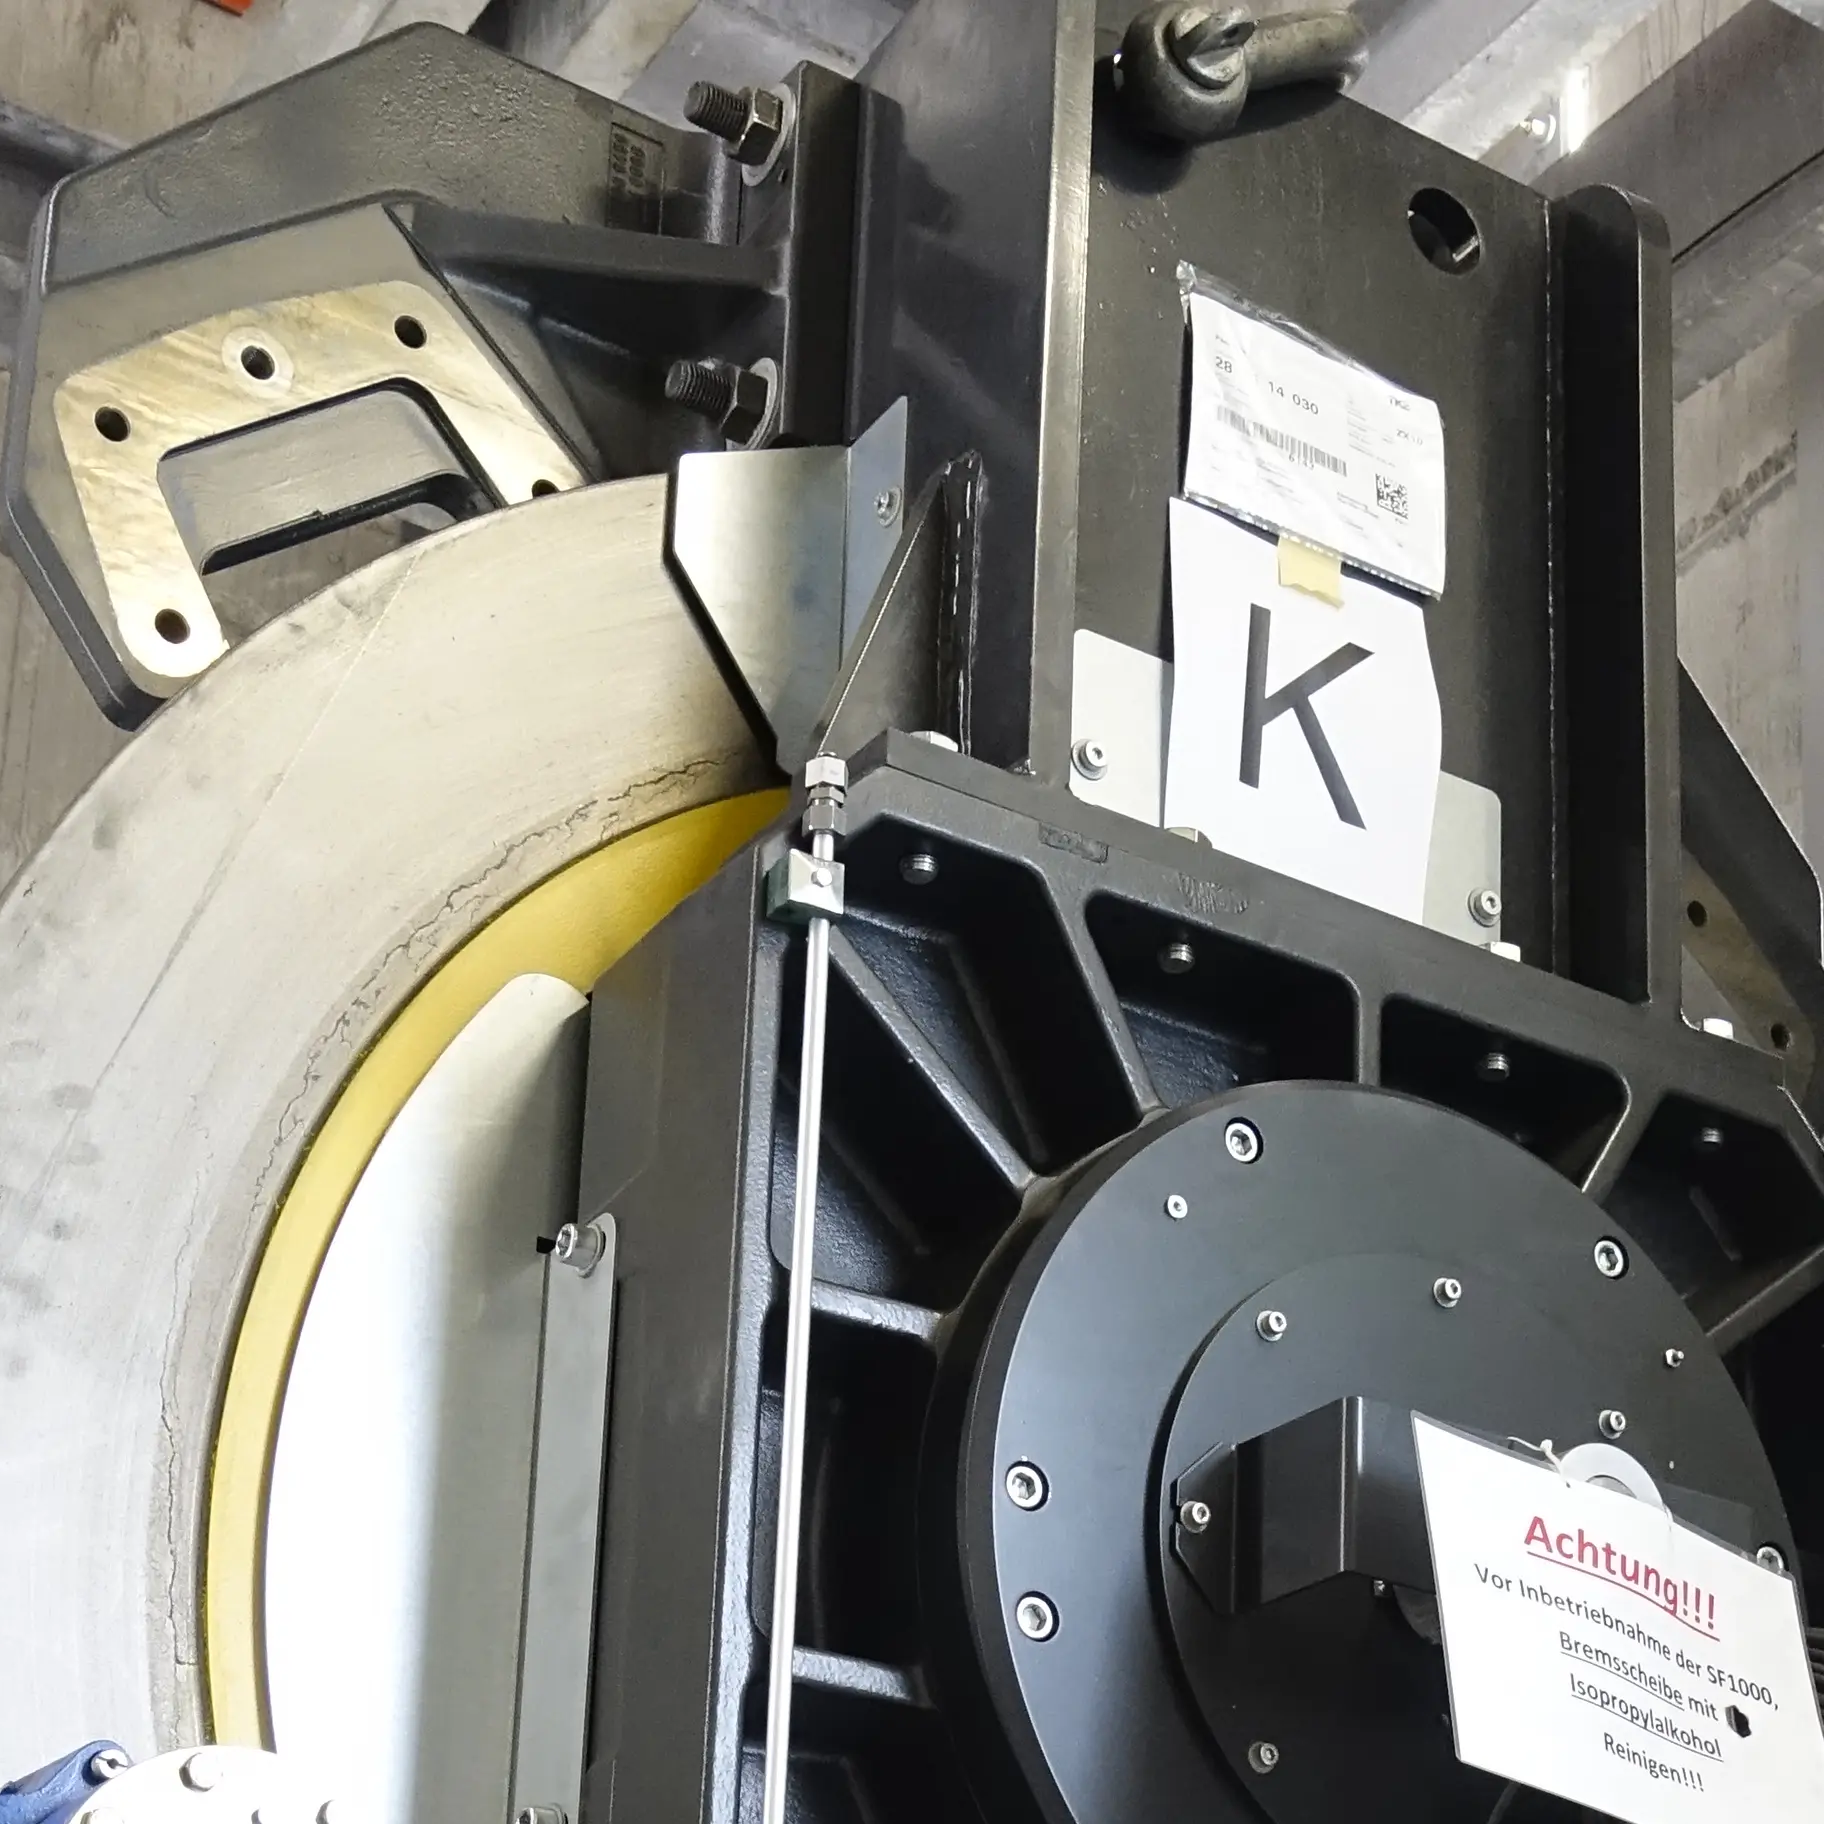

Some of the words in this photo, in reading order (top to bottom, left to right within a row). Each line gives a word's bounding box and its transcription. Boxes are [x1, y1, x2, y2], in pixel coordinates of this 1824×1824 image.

[1214, 355, 1233, 374] 28
[1268, 380, 1285, 398] 14
[1292, 393, 1319, 415] 030
[1239, 602, 1375, 830] K
[1524, 1516, 1715, 1630] Achtung!!!
[1474, 1563, 1513, 1592] Vor
[1519, 1579, 1671, 1661] Inbetriebnahme
[1676, 1648, 1704, 1677] der
[1707, 1665, 1778, 1711] SF1000,
[1559, 1631, 1683, 1705] Bremsscheibe
[1688, 1694, 1719, 1721] mit
[1569, 1673, 1723, 1758] Isopropylalkohol
[1604, 1732, 1706, 1792] Reinigen!!!
